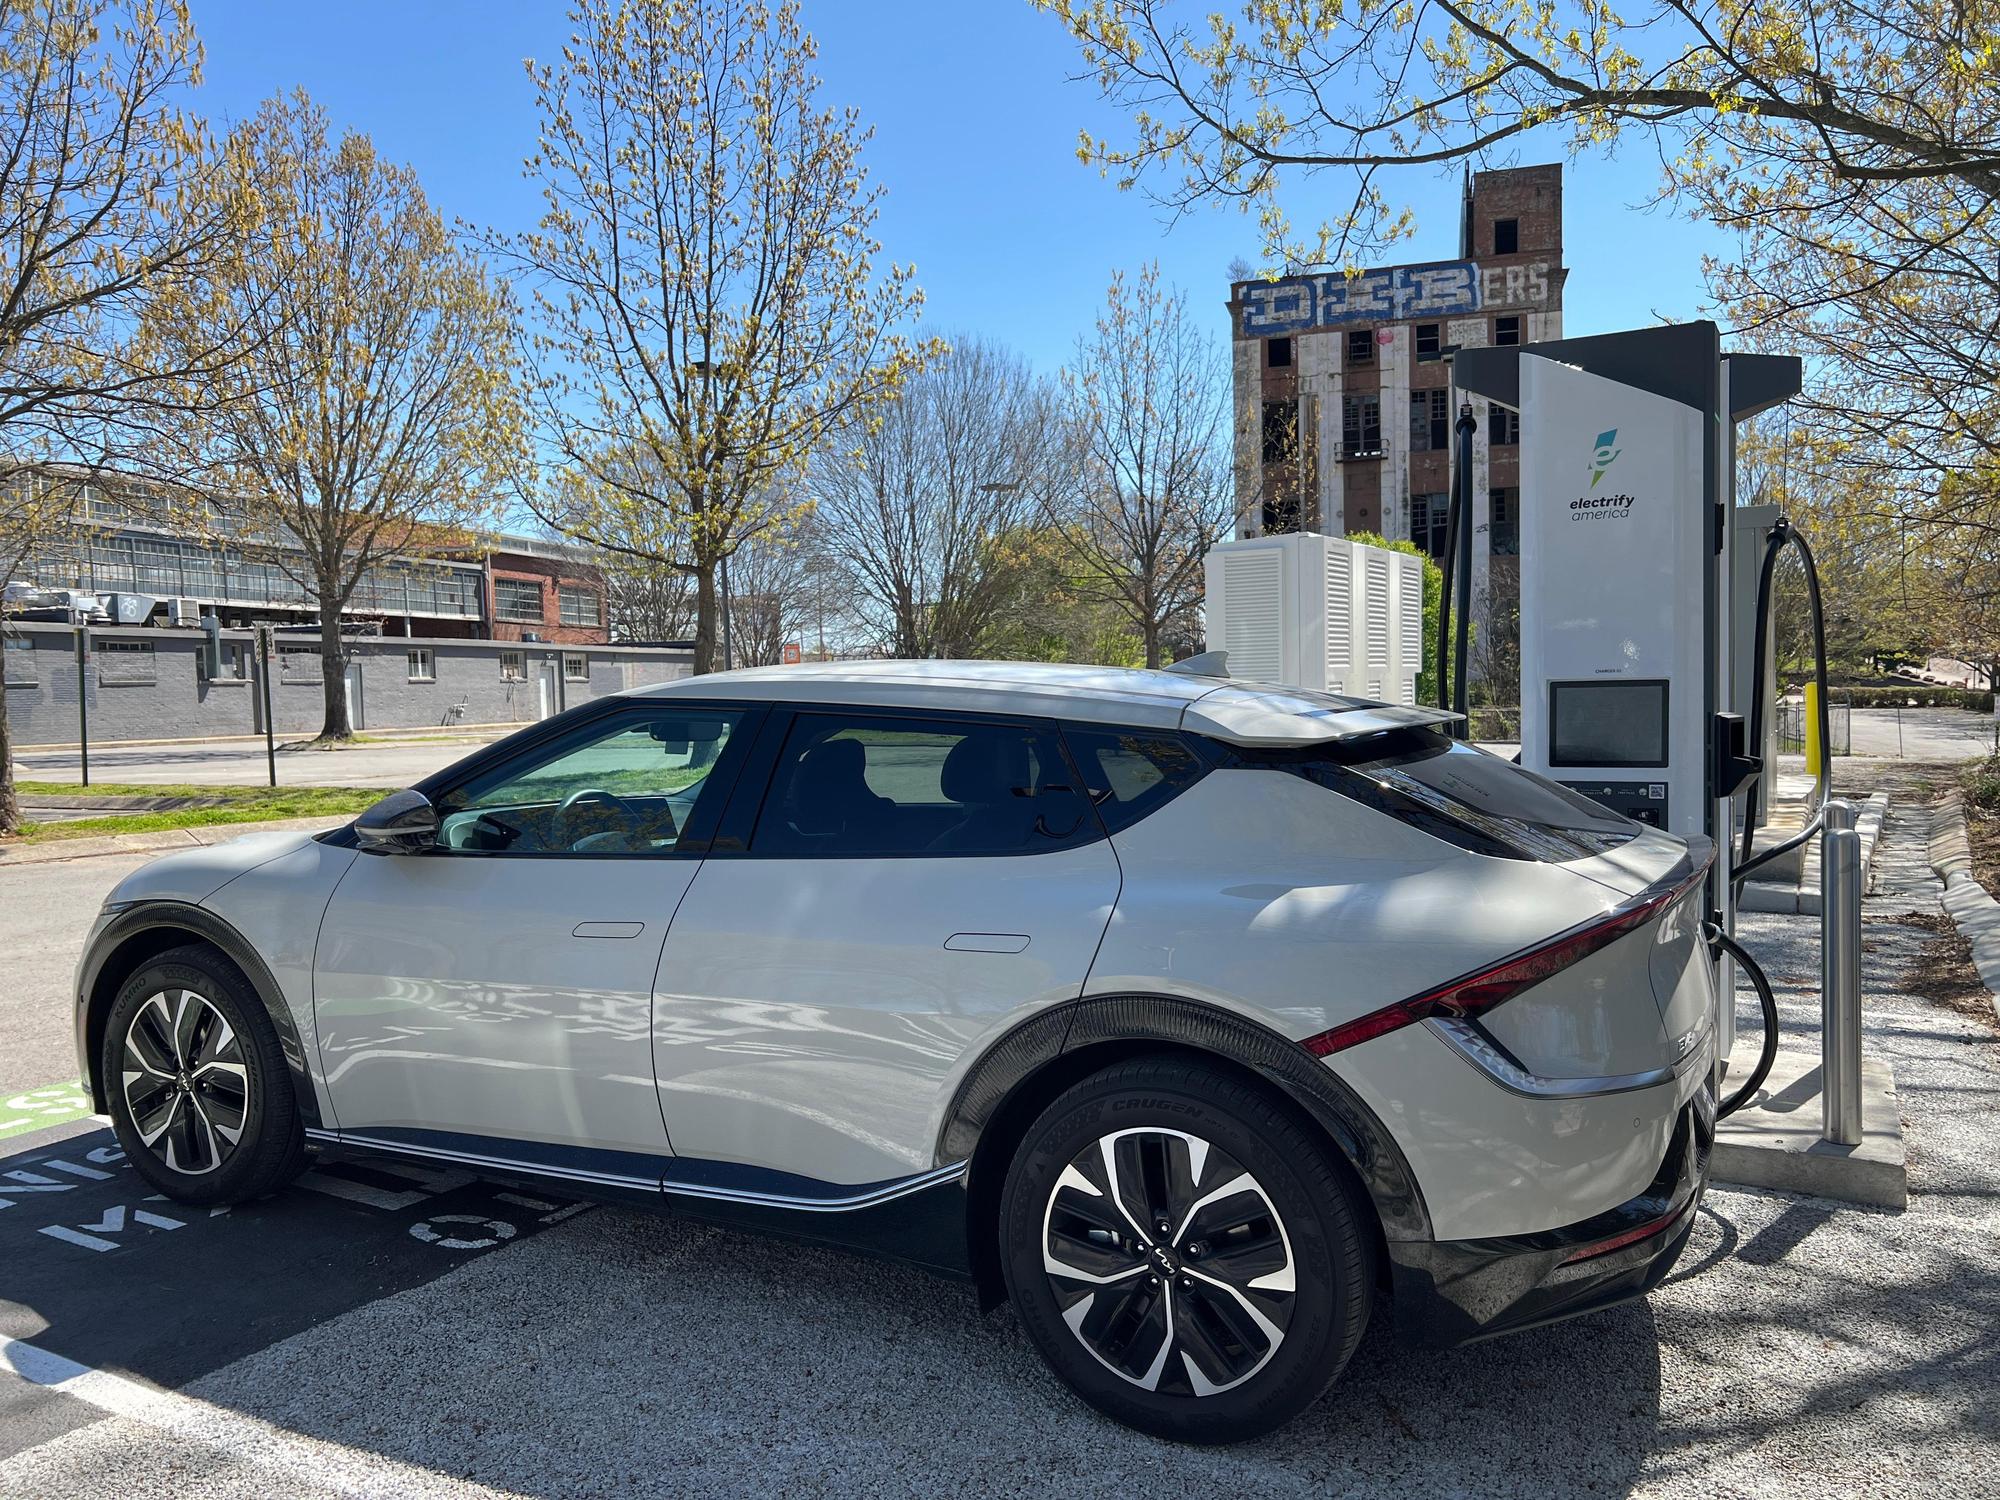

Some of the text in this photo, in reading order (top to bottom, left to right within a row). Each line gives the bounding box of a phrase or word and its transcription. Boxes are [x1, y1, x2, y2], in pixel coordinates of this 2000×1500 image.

[1569, 494, 1635, 509] electrify
[1571, 508, 1630, 521] america
[114, 977, 146, 1018] KUMHO
[1111, 1098, 1204, 1118] CRUGEN
